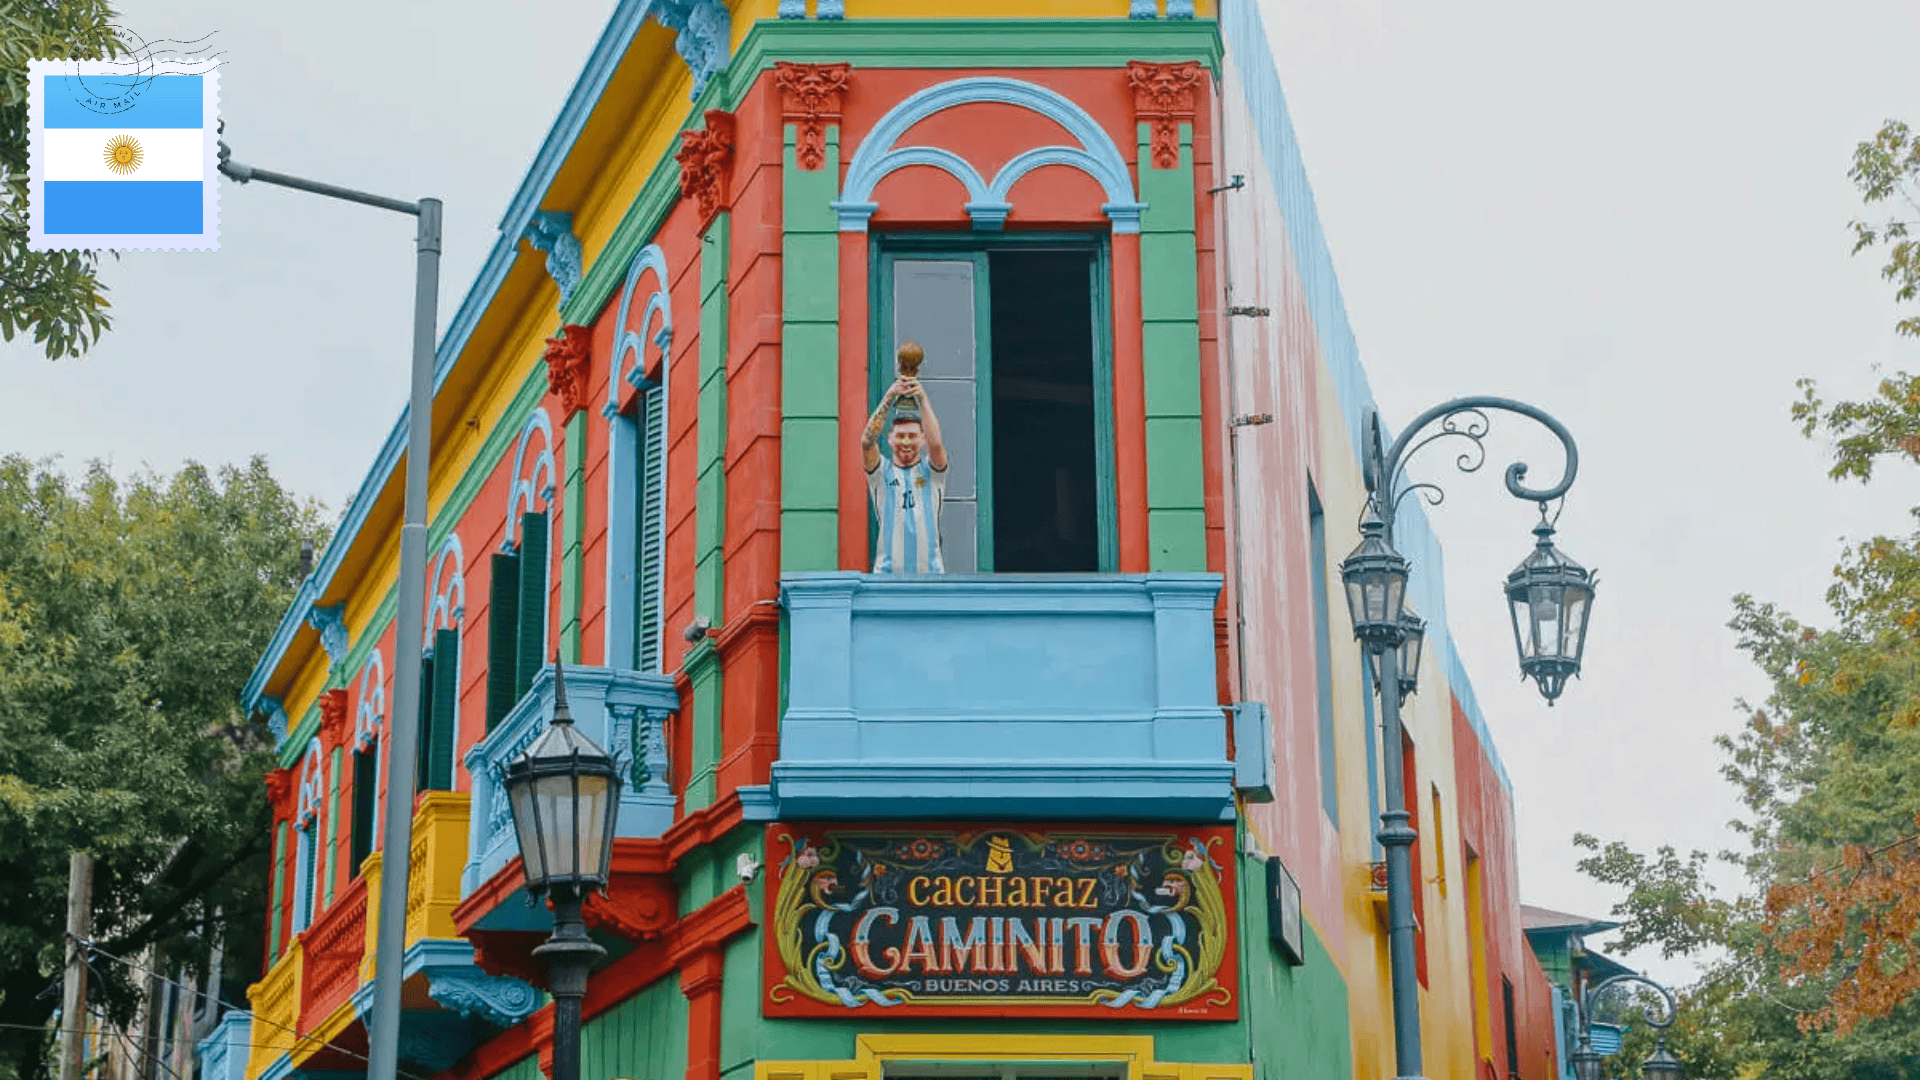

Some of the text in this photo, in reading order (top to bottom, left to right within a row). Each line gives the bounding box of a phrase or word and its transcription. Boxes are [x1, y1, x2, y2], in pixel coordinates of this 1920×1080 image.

[850, 906, 1154, 980] CAMINITO
[925, 979, 1080, 992] BUENOS AIRES
